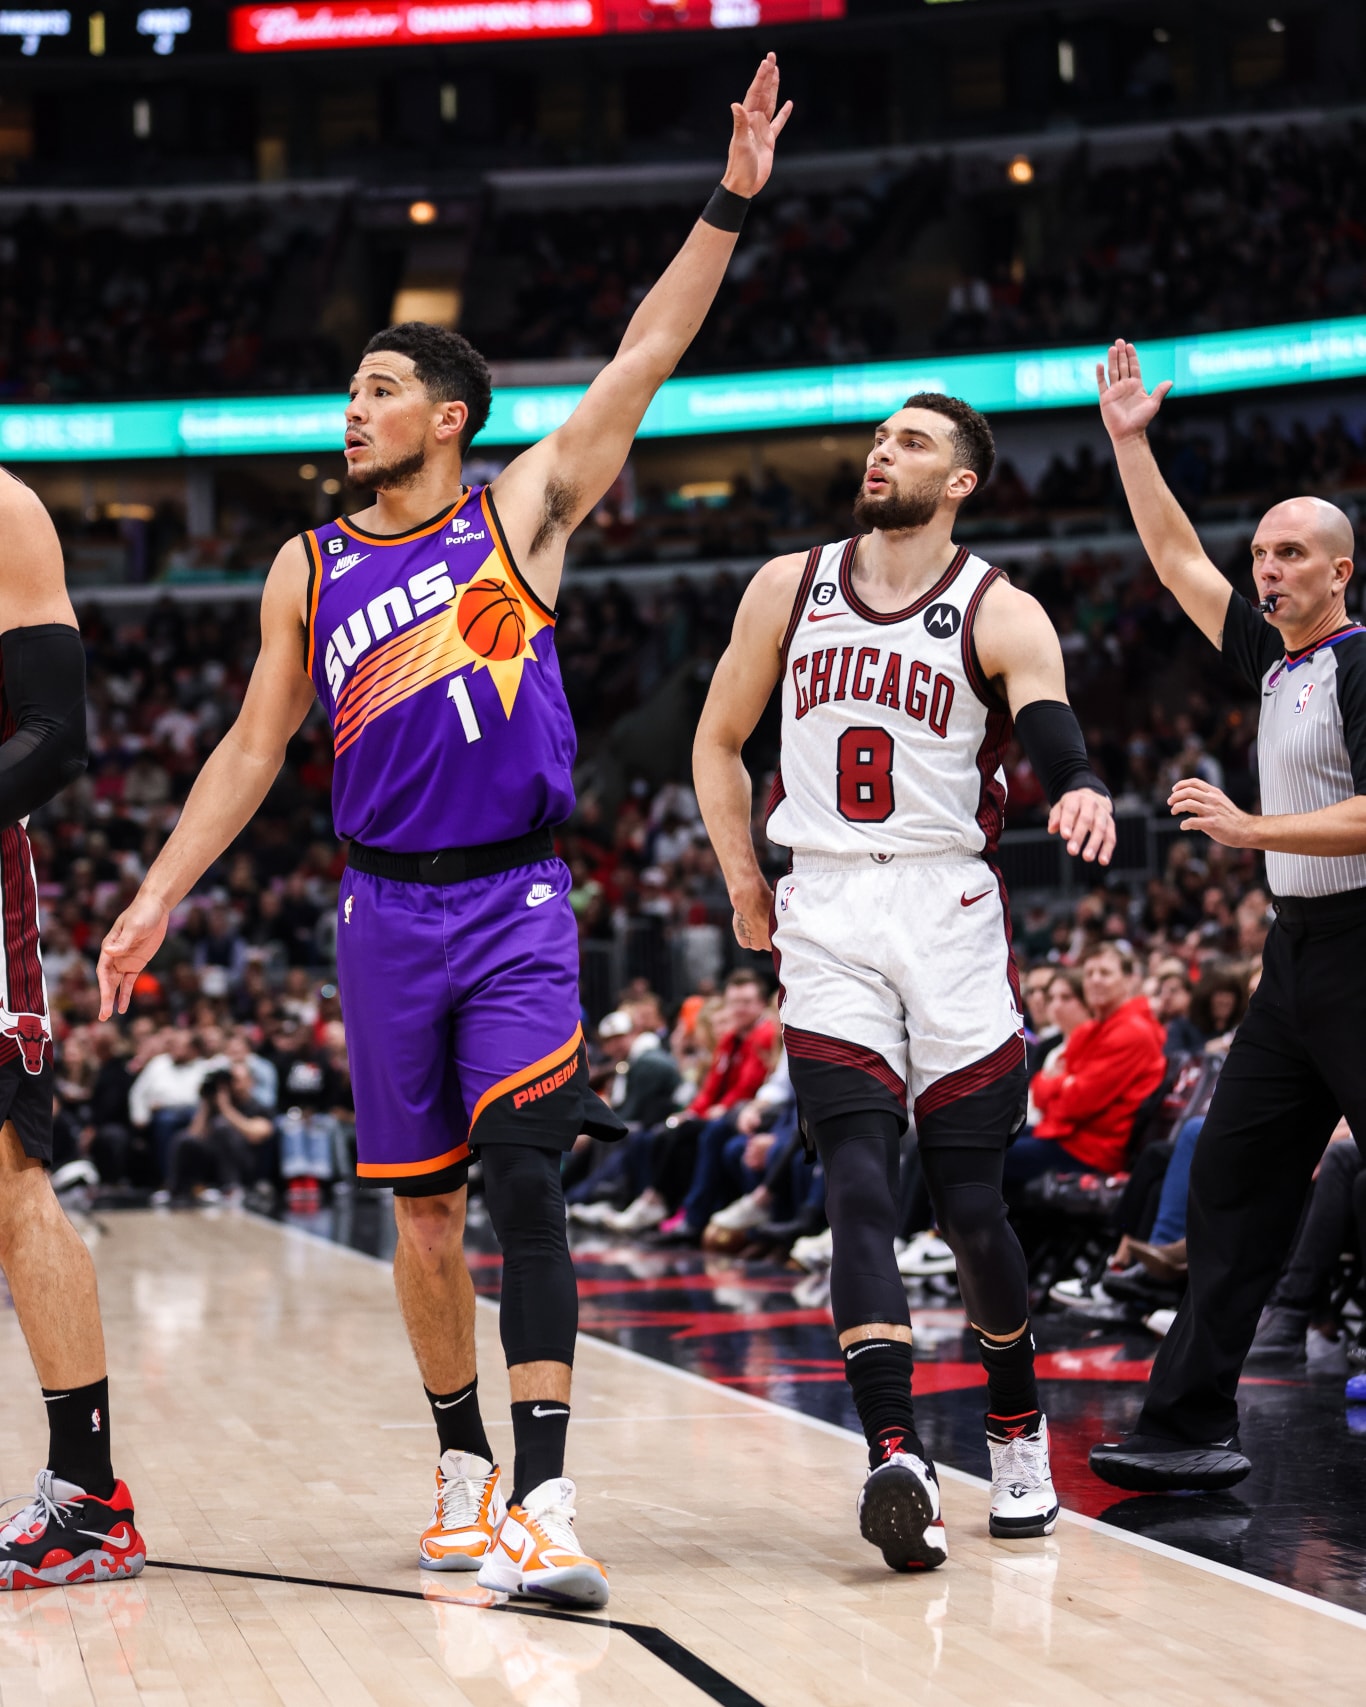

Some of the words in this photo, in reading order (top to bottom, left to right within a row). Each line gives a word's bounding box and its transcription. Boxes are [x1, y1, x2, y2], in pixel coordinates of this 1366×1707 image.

[327, 537, 344, 555] 6
[445, 529, 485, 546] PayPal
[335, 553, 361, 571] NIKE
[816, 584, 834, 604] 6
[325, 560, 457, 702] SUNS
[446, 674, 482, 744] 1
[792, 646, 955, 739] CHICAGO
[836, 726, 896, 823] 8
[531, 884, 552, 898] NIKE
[513, 1054, 579, 1110] PHOENIX
